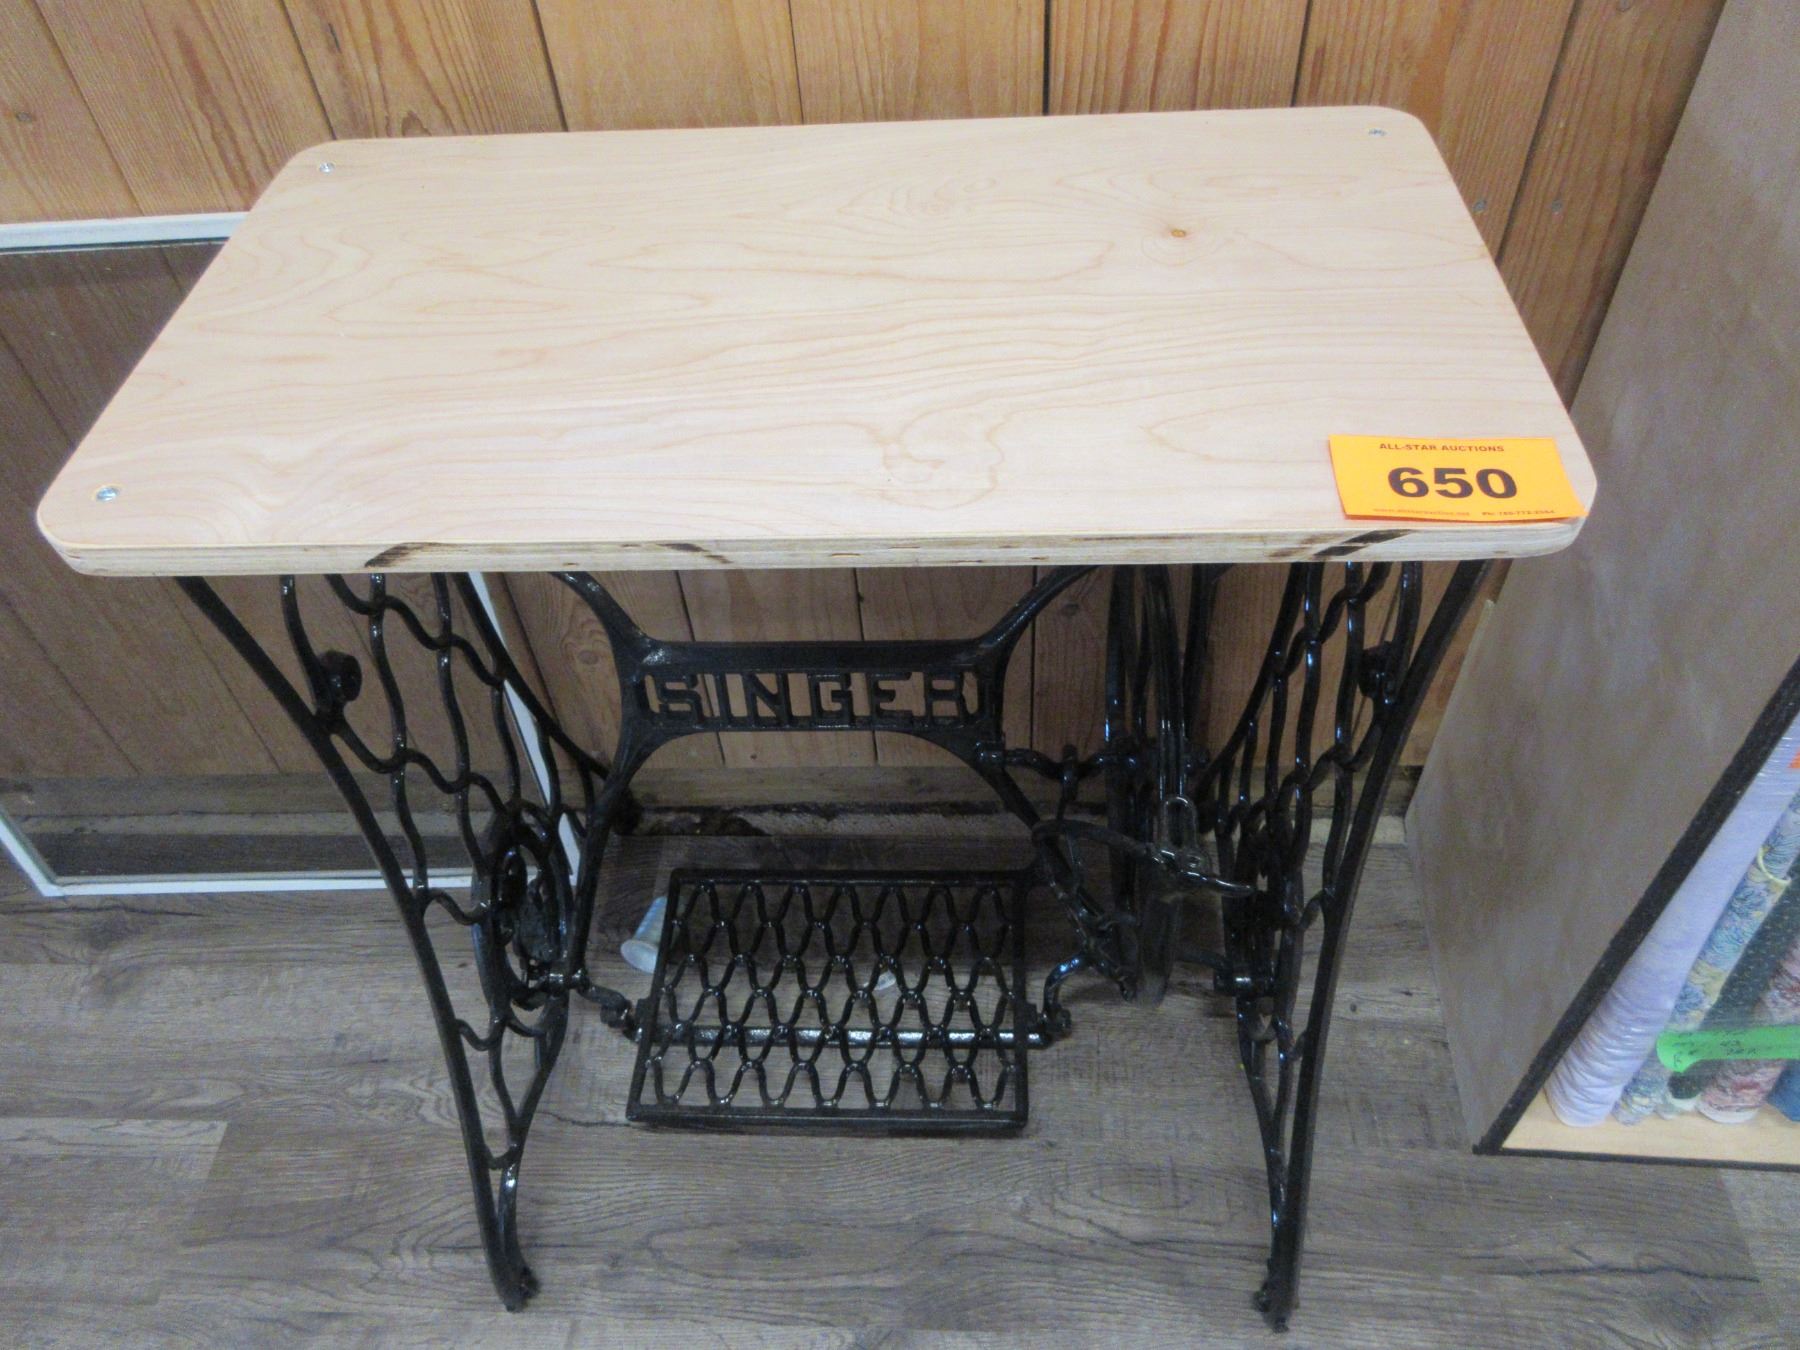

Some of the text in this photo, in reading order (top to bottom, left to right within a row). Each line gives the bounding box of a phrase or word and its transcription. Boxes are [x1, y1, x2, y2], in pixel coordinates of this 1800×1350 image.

[1379, 443, 1437, 451] ALL-STAR
[1388, 467, 1517, 499] 650
[653, 671, 970, 724] SINGER
